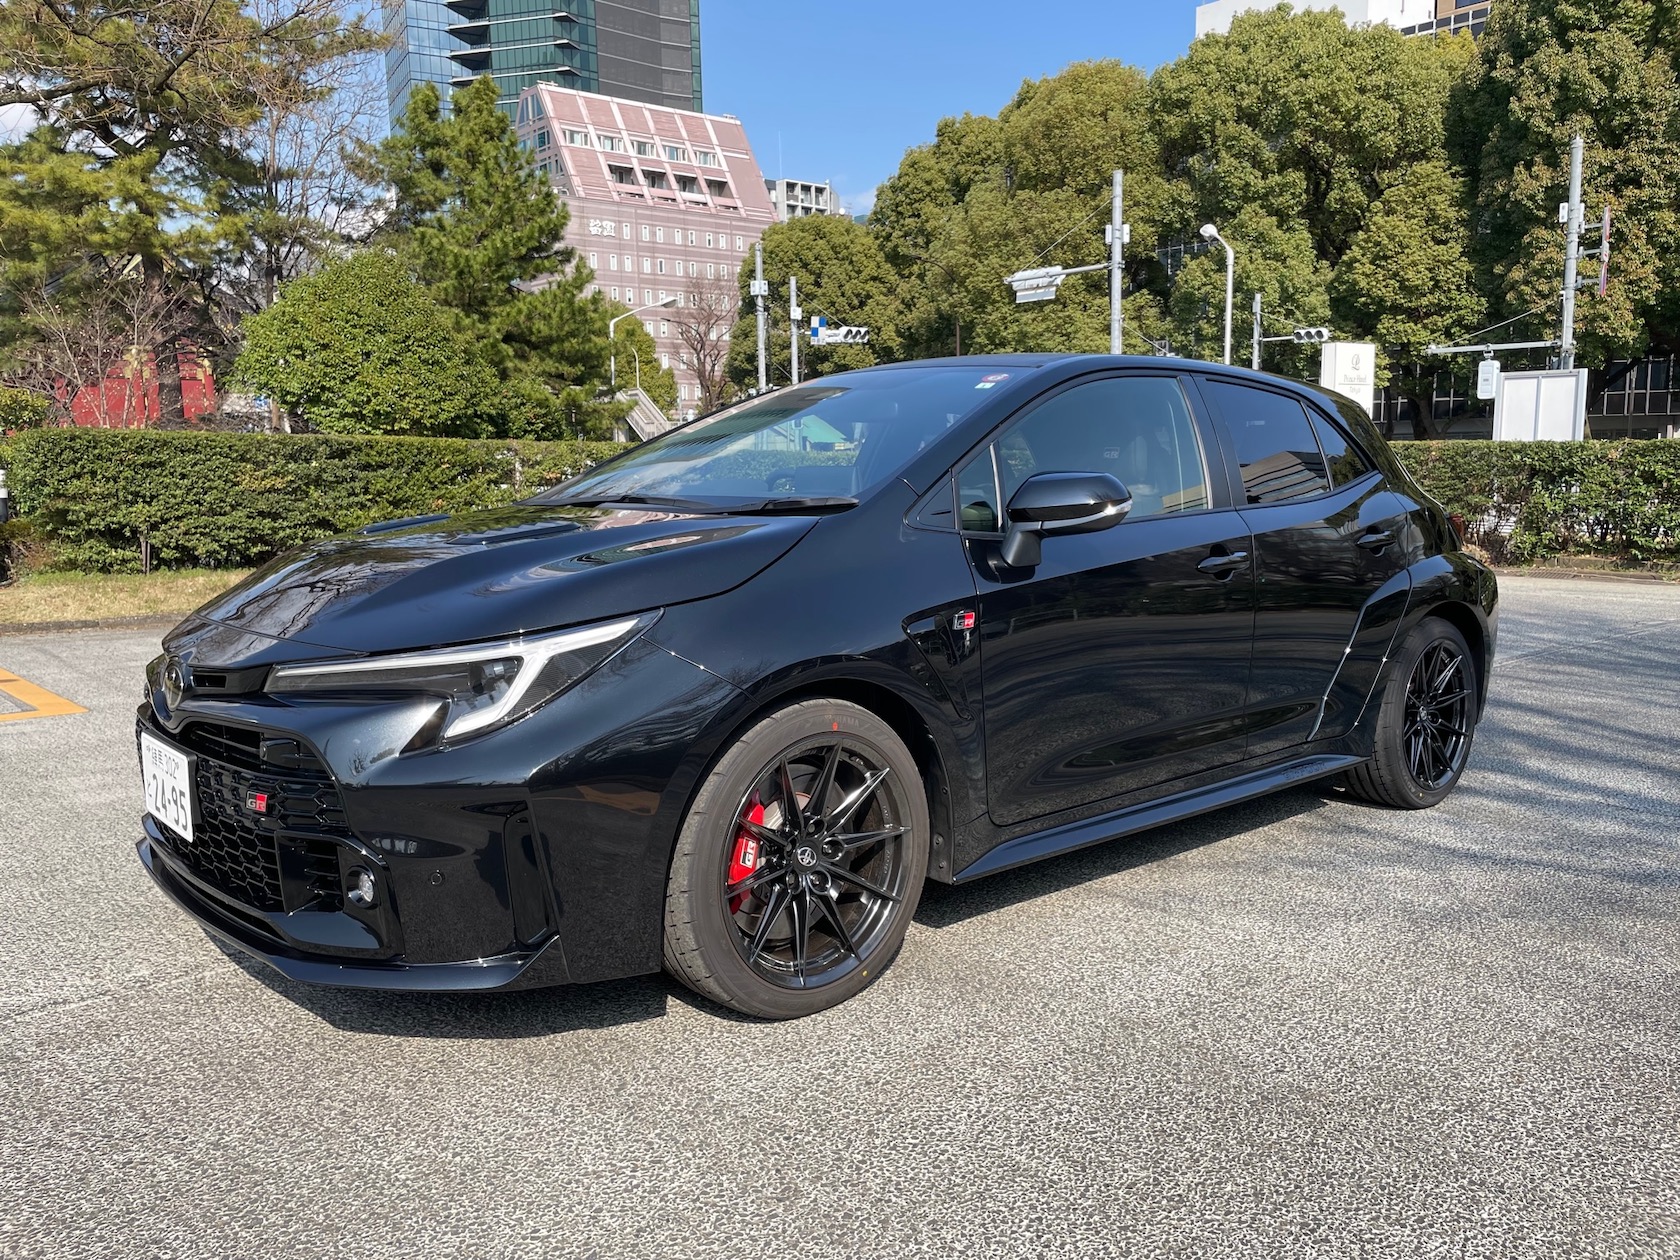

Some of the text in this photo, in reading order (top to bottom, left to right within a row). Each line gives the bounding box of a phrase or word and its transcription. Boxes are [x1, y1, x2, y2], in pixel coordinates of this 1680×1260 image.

[164, 754, 178, 780] 302
[152, 773, 188, 832] 24-95
[247, 797, 267, 811] GR
[744, 840, 756, 867] GR
